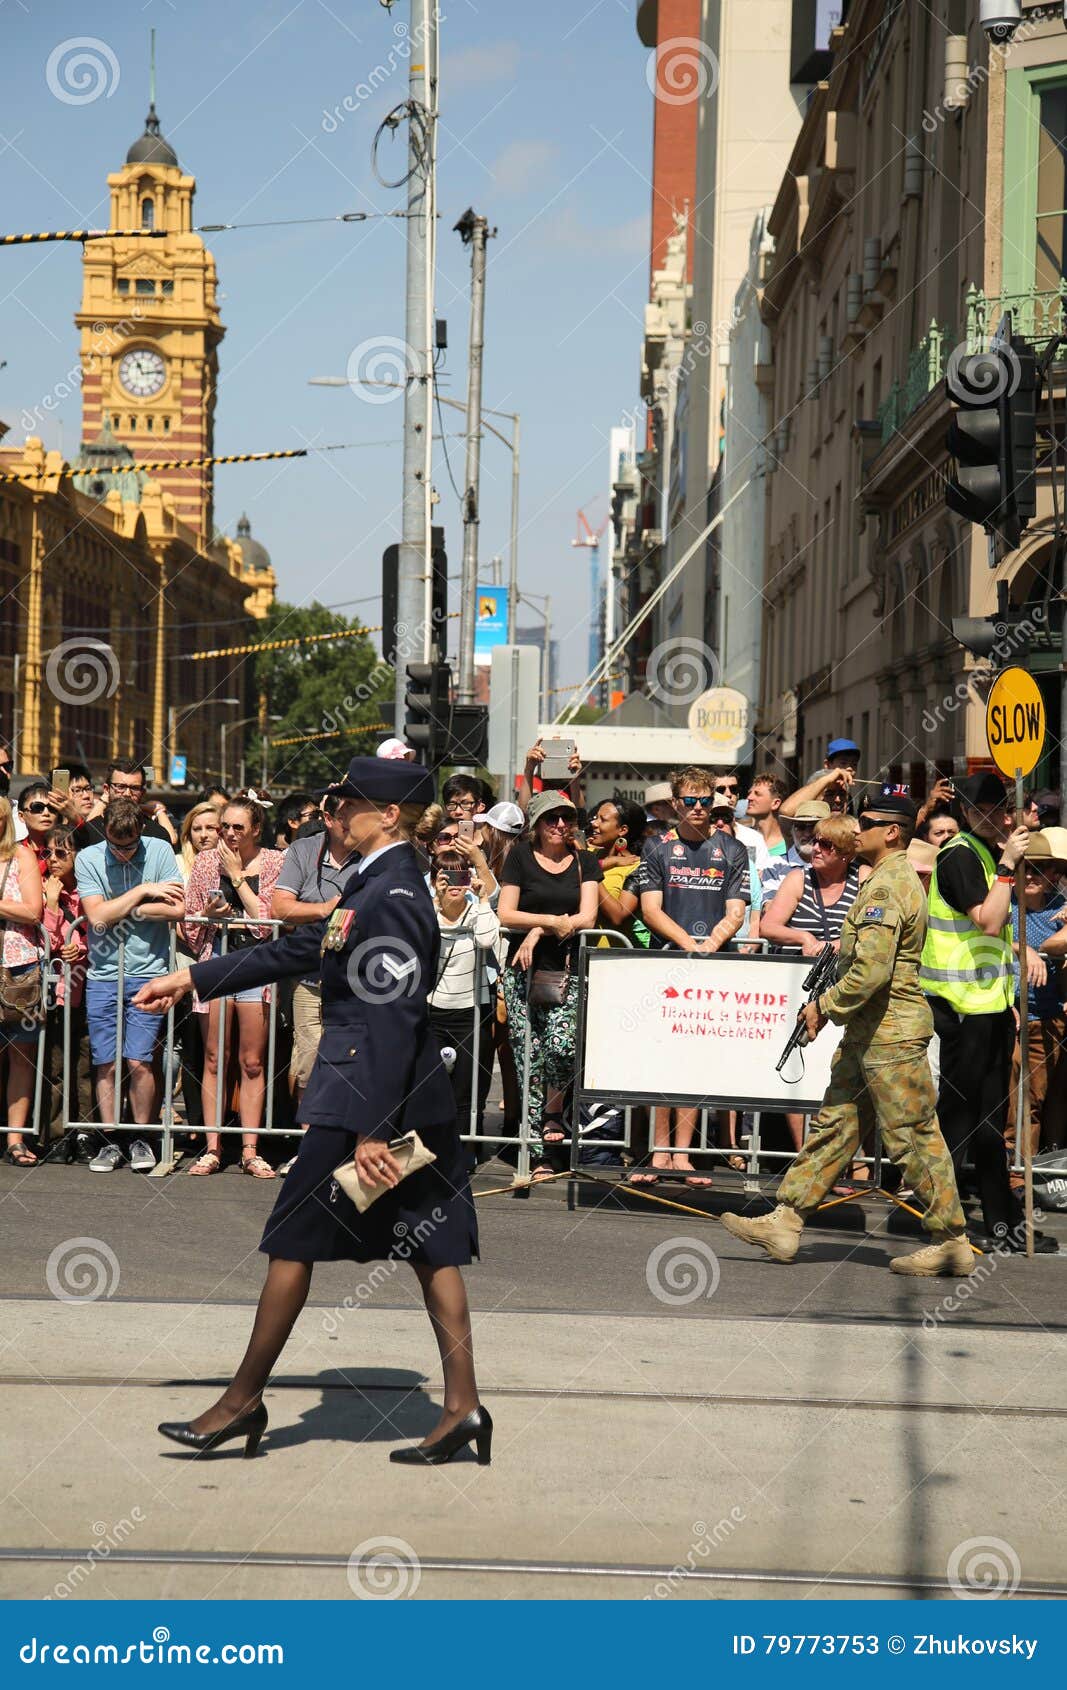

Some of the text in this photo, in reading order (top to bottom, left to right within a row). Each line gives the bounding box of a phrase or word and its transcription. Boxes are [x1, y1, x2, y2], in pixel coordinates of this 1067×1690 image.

[697, 708, 748, 728] BOTTLE
[991, 702, 1040, 745] SLOW
[669, 875, 725, 886] RACING
[736, 1010, 787, 1024] EVENTS
[671, 1023, 773, 1040] MANAGEMENT
